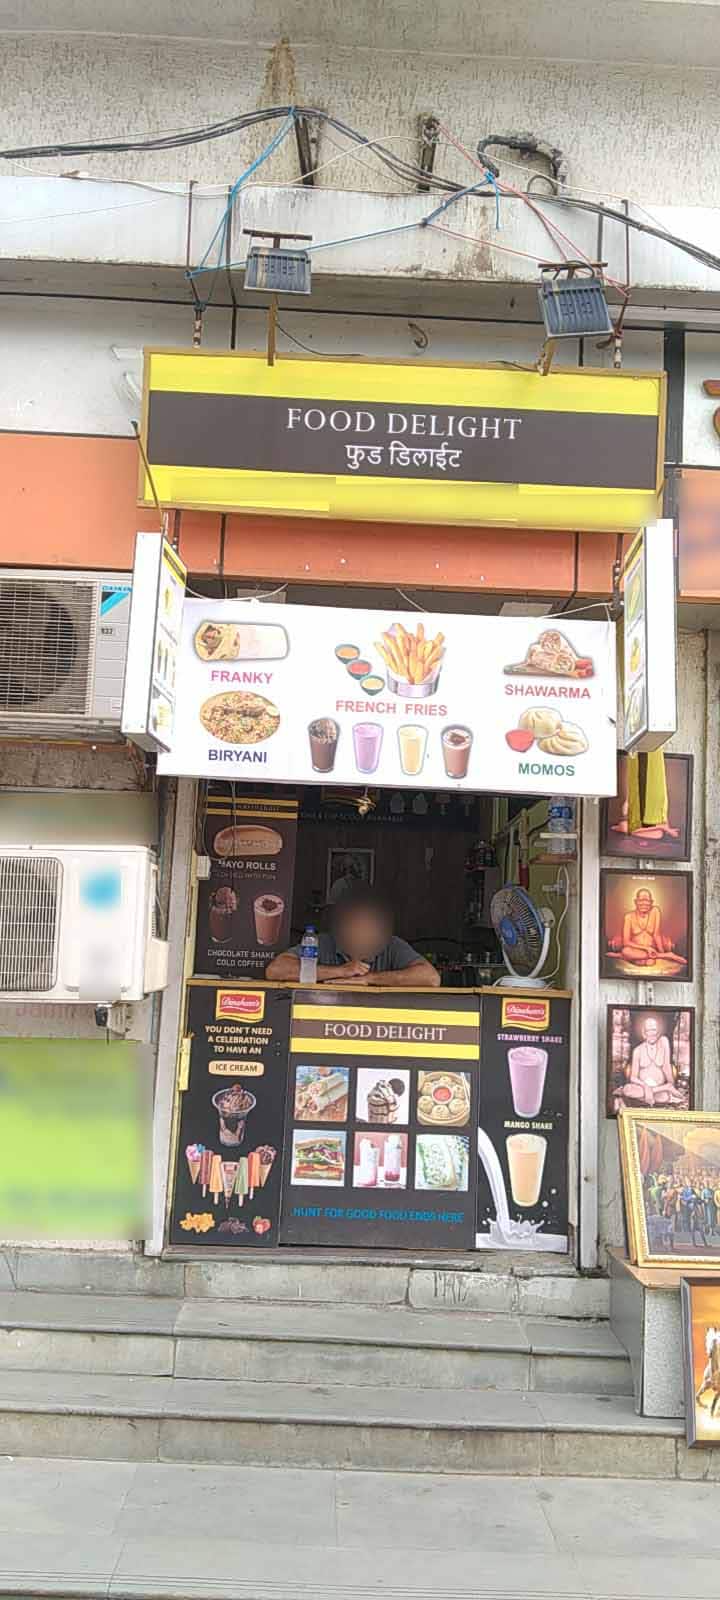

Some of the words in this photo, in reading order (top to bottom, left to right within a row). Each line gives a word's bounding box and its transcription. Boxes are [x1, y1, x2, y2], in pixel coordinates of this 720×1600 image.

[287, 408, 376, 433] FOOD
[388, 412, 522, 440] DELIGHT
[344, 444, 384, 469] फुड
[389, 440, 463, 470] डिलाईट
[210, 670, 273, 684] FRANKY
[504, 684, 591, 699] SHAWARMA
[335, 700, 397, 714] FRENCH
[405, 704, 448, 716] FRIES
[208, 749, 267, 763] BIRYANI
[518, 763, 575, 777] MOMOS
[246, 861, 277, 871] ROLLS
[207, 950, 249, 958] CHOCOLATE
[250, 952, 275, 960] SHAKE
[216, 959, 236, 967] COLD
[237, 960, 265, 968] COFFEE
[205, 1025, 222, 1033] YOU
[223, 1026, 250, 1034] DON'T
[251, 1027, 273, 1035] NEED
[324, 1023, 372, 1038] FOOD
[376, 1025, 448, 1041] DELIGHT
[207, 1035, 214, 1043] A
[215, 1036, 269, 1045] CELEBRATION
[497, 1033, 540, 1042] STRAWBERRY
[213, 1045, 224, 1053] TO
[226, 1046, 247, 1054] HAVE
[249, 1047, 262, 1055] AN
[215, 1063, 227, 1071] ICE
[229, 1064, 258, 1073] CREAM
[504, 1120, 530, 1129] MANGO
[531, 1122, 553, 1130] SHAKE
[293, 1207, 321, 1217] HUNT
[324, 1208, 344, 1217] FOR
[346, 1209, 376, 1219] GOOD
